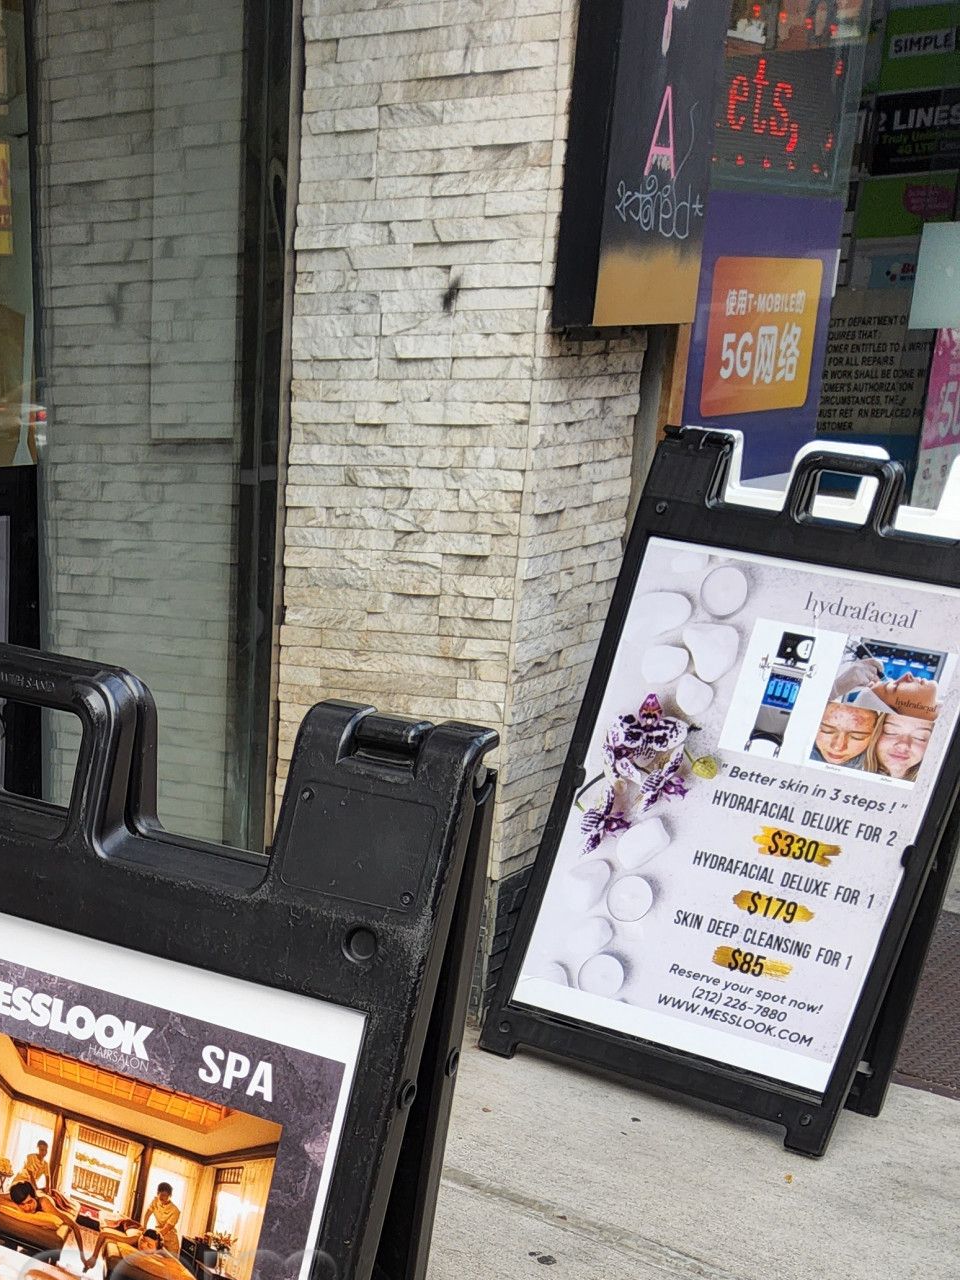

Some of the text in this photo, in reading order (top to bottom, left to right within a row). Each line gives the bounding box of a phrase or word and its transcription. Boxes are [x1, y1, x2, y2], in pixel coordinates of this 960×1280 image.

[894, 32, 953, 54] SIMPLE
[848, 316, 897, 327] DEPARTMENT
[719, 322, 802, 385] 5G网络
[830, 369, 852, 380] WORK
[855, 369, 880, 379] SHALL
[881, 369, 891, 379] BE
[803, 591, 920, 632] hydrafacial
[729, 766, 777, 787] Better
[779, 778, 809, 795] skin
[811, 784, 826, 799] in
[829, 788, 841, 801] 3
[843, 793, 886, 815] steps
[712, 789, 898, 847] HYDRAFACIAL DELUXE FOR 2
[768, 831, 819, 864] $330
[693, 850, 875, 909] HYDRAFACIAL DELUXE FOR 1
[747, 891, 798, 924] $179
[673, 909, 853, 970] SKIN DEEP CLEANSING FOR 1
[727, 947, 766, 978] $85
[669, 963, 824, 1015] Reserve your spot now!
[691, 985, 788, 1022] (212) 226-7880
[656, 993, 813, 1048] WWW.MESSLOOK.COM
[198, 1044, 274, 1103] SPA
